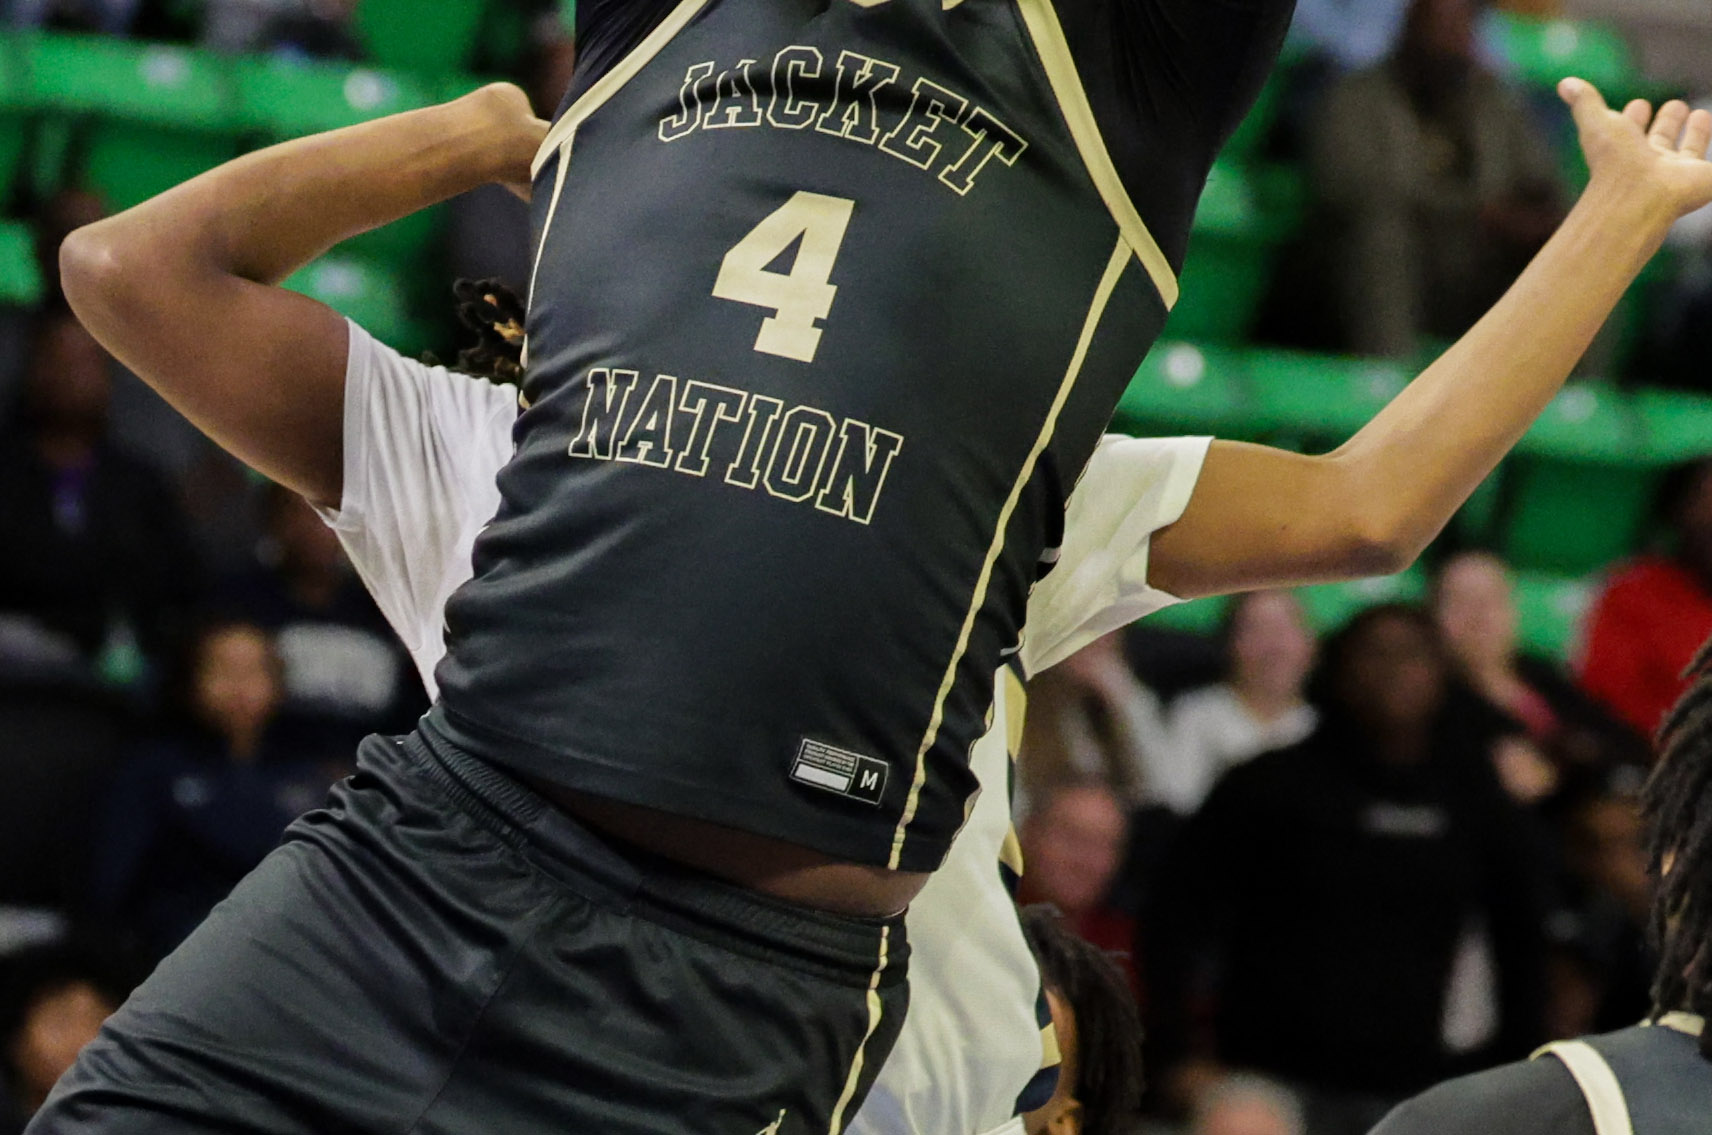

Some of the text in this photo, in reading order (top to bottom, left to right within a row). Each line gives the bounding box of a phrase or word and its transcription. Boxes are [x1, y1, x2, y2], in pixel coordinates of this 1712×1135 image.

[658, 45, 1028, 196] JACKET
[711, 190, 855, 363] 4
[568, 368, 904, 525] NATION
[860, 769, 878, 791] M
